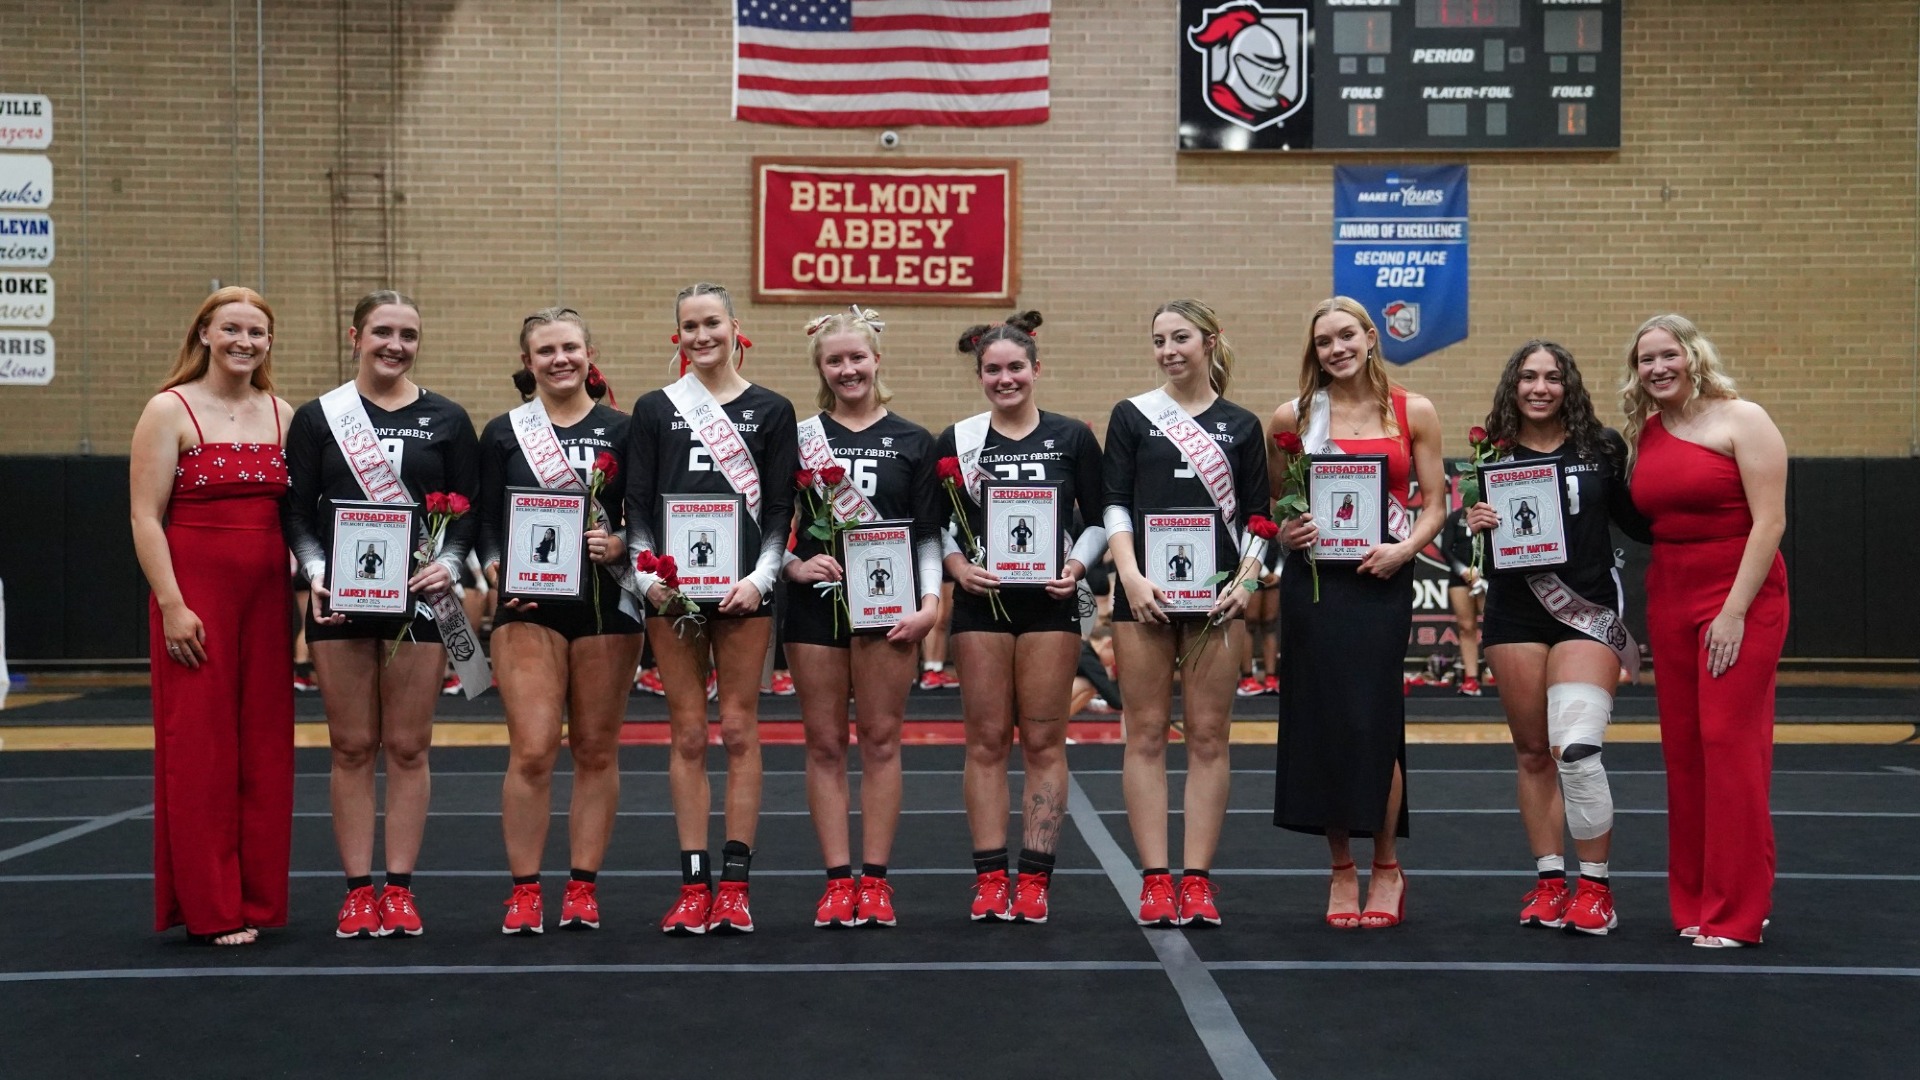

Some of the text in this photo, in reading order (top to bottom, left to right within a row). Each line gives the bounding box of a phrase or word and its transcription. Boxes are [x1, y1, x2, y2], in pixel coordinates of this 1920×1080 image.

[1412, 48, 1475, 63] PERIOD
[1341, 86, 1384, 99] FOULS
[1551, 85, 1594, 98] FOULS
[790, 181, 977, 214] BELMONT
[1357, 185, 1444, 207] MAKE IT YOURS
[815, 217, 953, 249] ABBEY
[1339, 223, 1462, 238] AWARD OF EXCELLENCE
[1354, 251, 1448, 265] SECOND PLACE
[792, 252, 974, 286] COLLEGE
[1375, 266, 1425, 287] 2021
[397, 428, 434, 440] ABBEY
[579, 437, 613, 448] ABBEY
[864, 448, 900, 459] ABBEY
[1029, 452, 1063, 461] ABBEY
[1166, 419, 1237, 520] SENIOR
[1314, 465, 1377, 474] CRUSADERS
[1490, 468, 1553, 483] CRUSADERS
[992, 490, 1053, 499] CRUSADERS
[516, 497, 580, 508] CRUSADERS
[671, 504, 734, 513] CRUSADERS
[340, 512, 407, 523] CRUSADERS
[1149, 518, 1211, 526] CRUSADERS
[847, 530, 907, 542] CRUSADERS
[1499, 542, 1559, 556] TRINITY MARTINEZ
[1032, 562, 1046, 570] COX
[518, 572, 539, 582] KYLIE
[338, 588, 400, 599] LAUREN PHILLIPS
